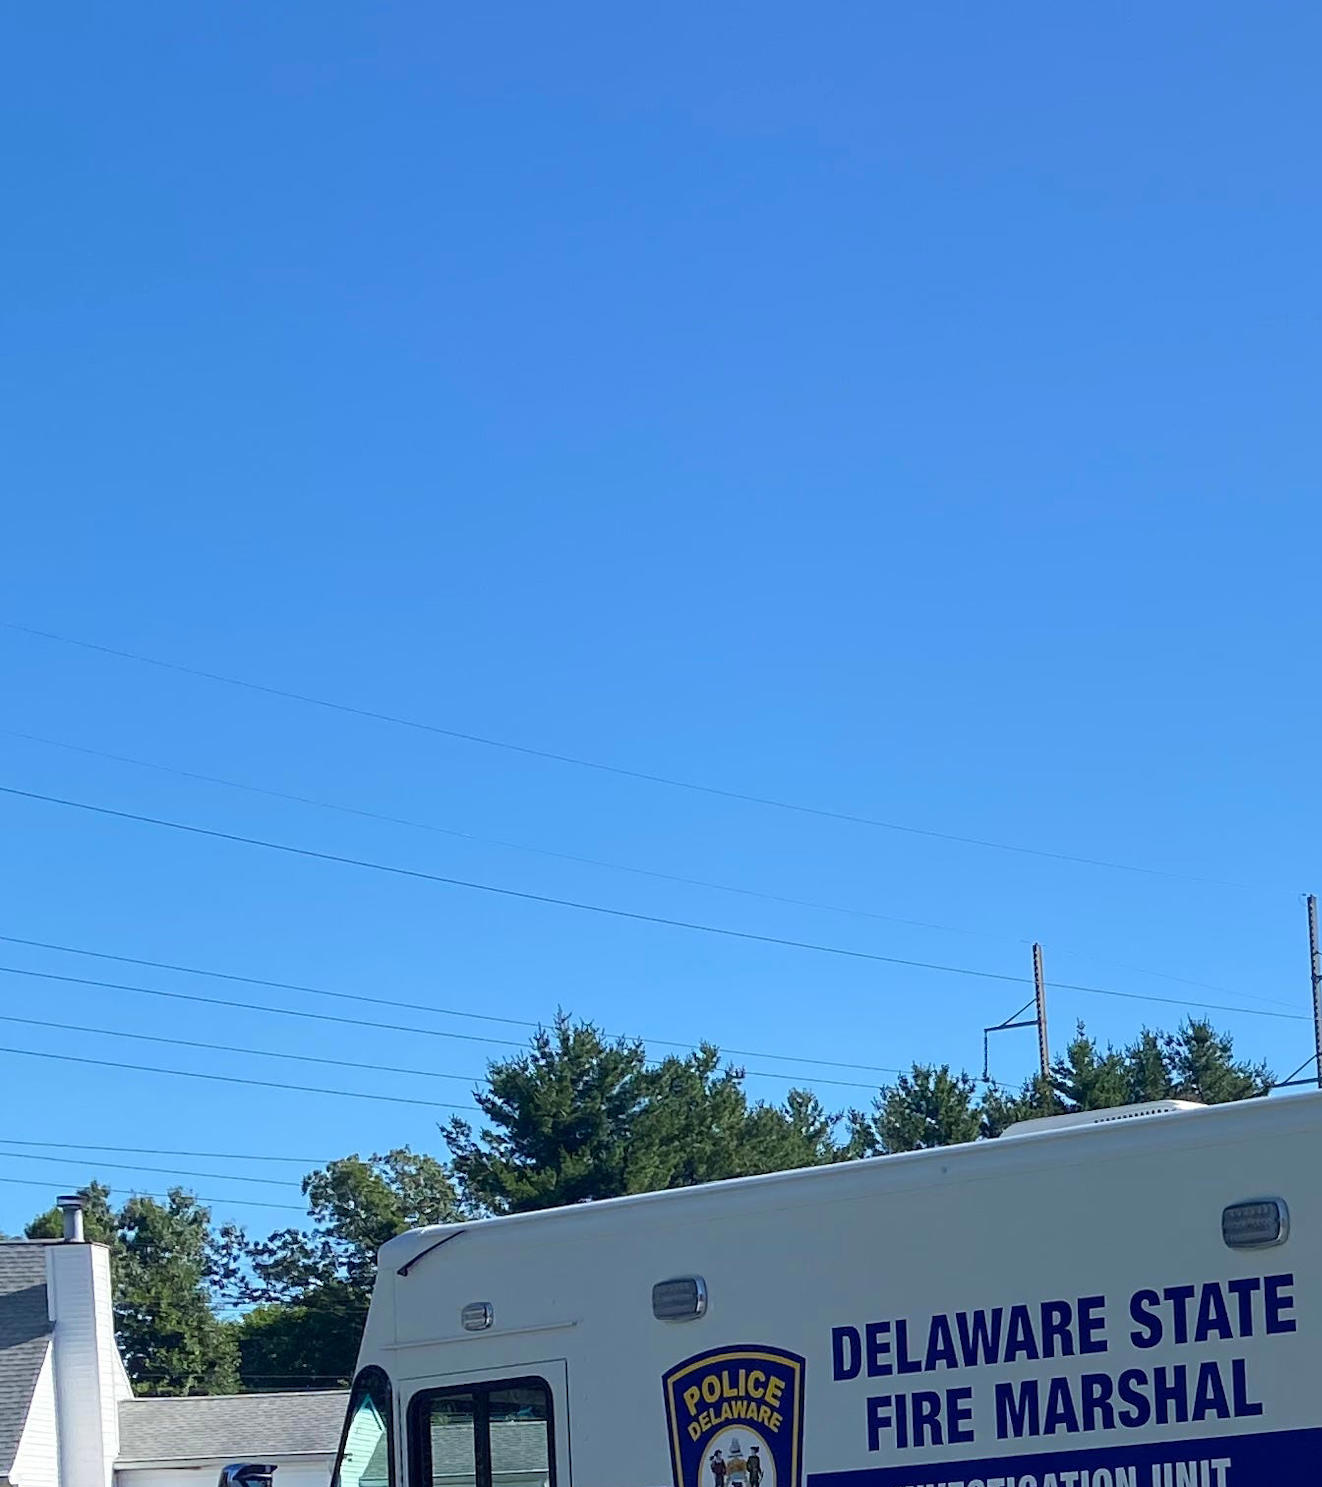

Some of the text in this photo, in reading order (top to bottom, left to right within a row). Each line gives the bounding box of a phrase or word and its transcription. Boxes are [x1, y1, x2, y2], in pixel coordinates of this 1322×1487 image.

[831, 1273, 1297, 1382] DELAWARE STATE
[683, 1369, 786, 1416] POLICE
[687, 1401, 783, 1442] DELAWARE
[866, 1358, 1263, 1452] FIRE MARSHAL
